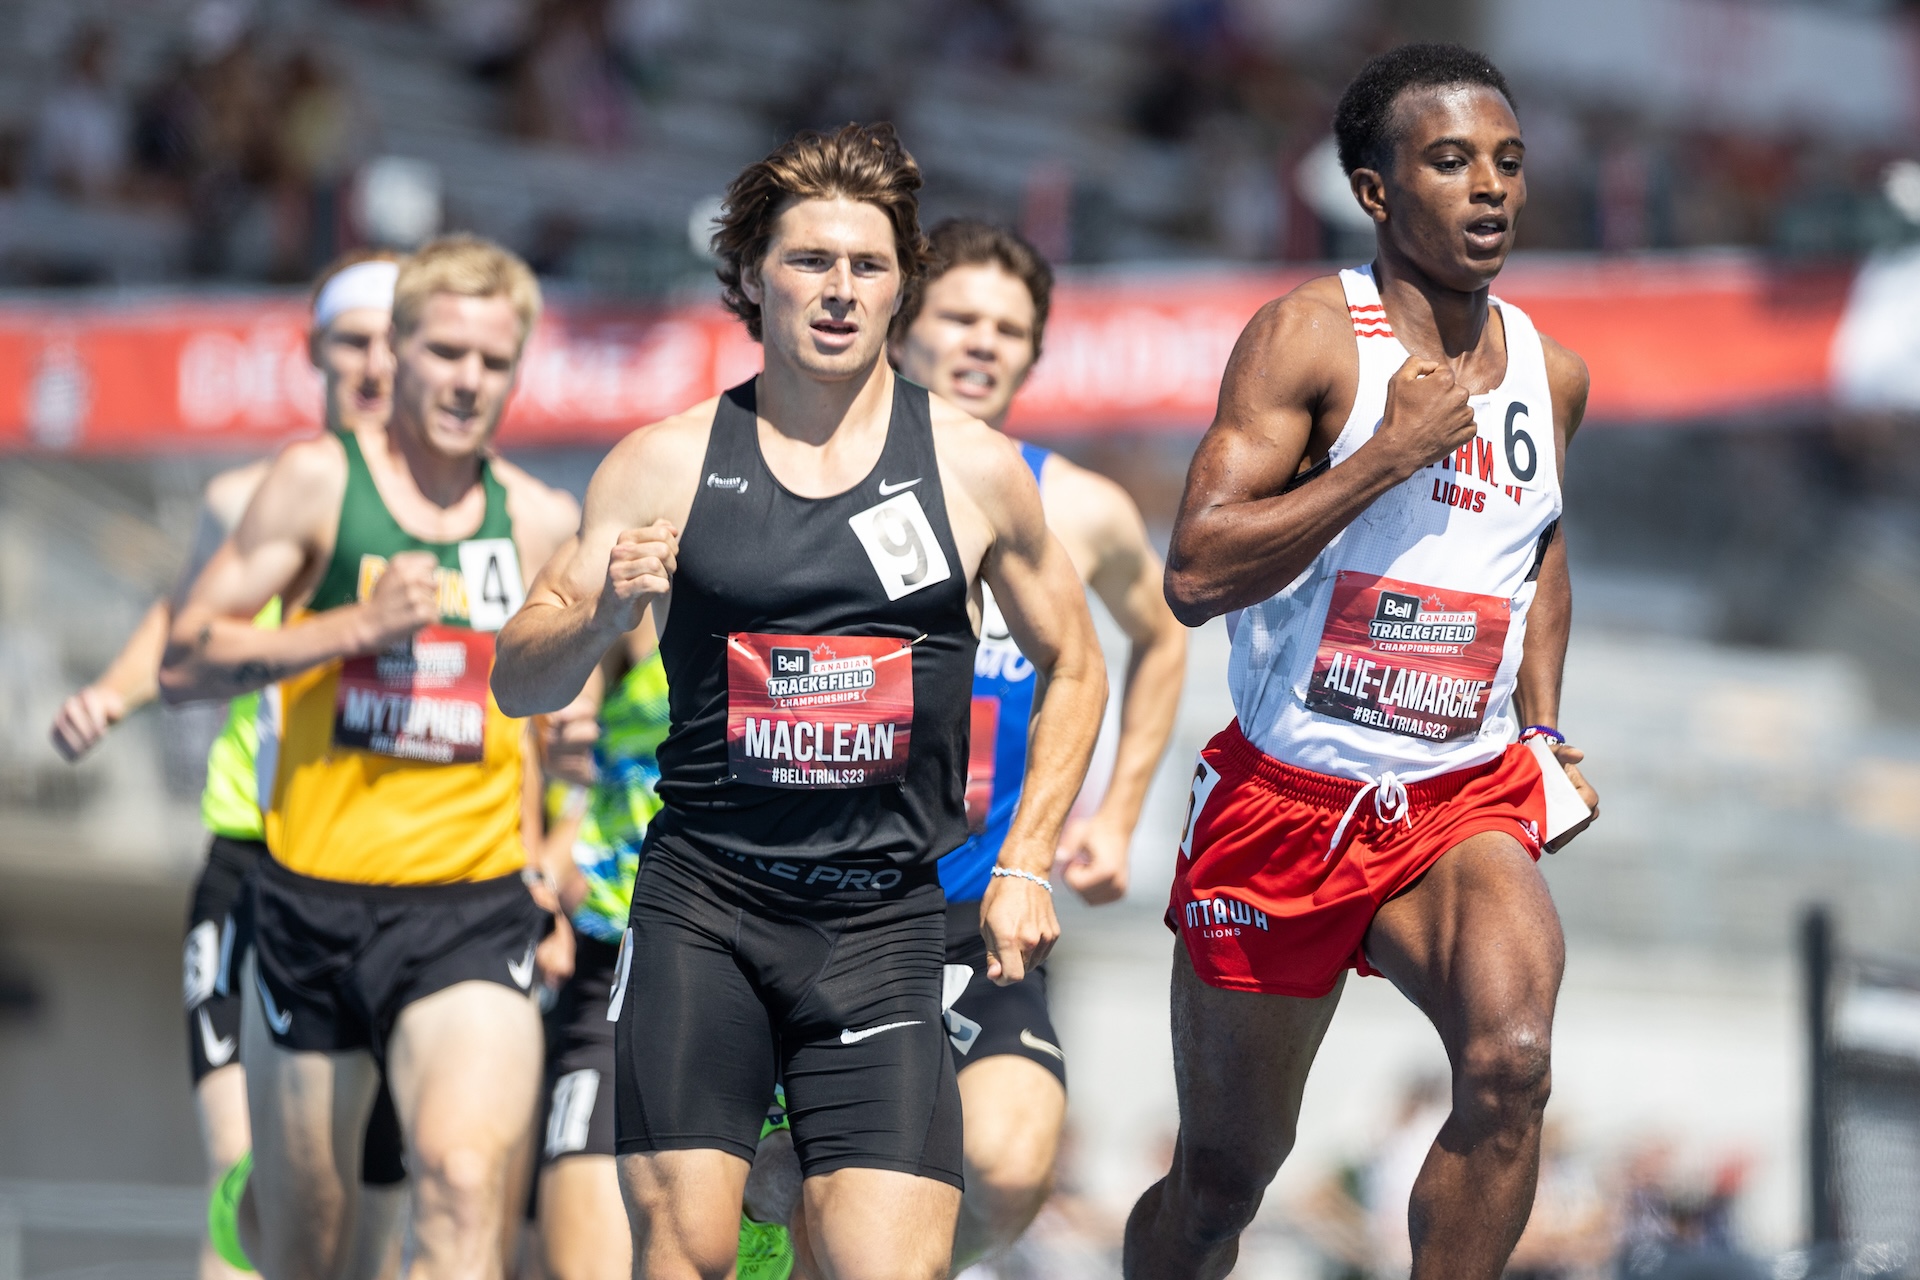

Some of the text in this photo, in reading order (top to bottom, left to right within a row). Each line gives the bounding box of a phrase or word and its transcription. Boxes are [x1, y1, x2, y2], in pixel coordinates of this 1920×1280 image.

[1504, 401, 1537, 482] 6
[1432, 478, 1486, 513] LIONS
[873, 507, 928, 586] 9
[483, 553, 510, 615] 4
[1384, 599, 1412, 618] Bell
[1419, 613, 1473, 623] CANADIAN
[1371, 622, 1474, 641] TRACK&FIELD
[1378, 642, 1458, 654] CHAMPIONSHIPS
[777, 655, 803, 672] Bell
[814, 659, 868, 673] CANADIAN
[769, 670, 873, 695] TRACK&FIELD
[1324, 652, 1487, 719] ALIE-LAMARCHE
[780, 692, 859, 707] CHAMPIONSHIPS
[1353, 706, 1448, 739] #BELLTRIALS23
[745, 717, 895, 762] MACLEAN
[772, 767, 864, 784] #BELLTRIALS23
[805, 865, 902, 890] PRO
[1186, 898, 1269, 932] OTTAWA
[1203, 928, 1241, 938] LIONS
